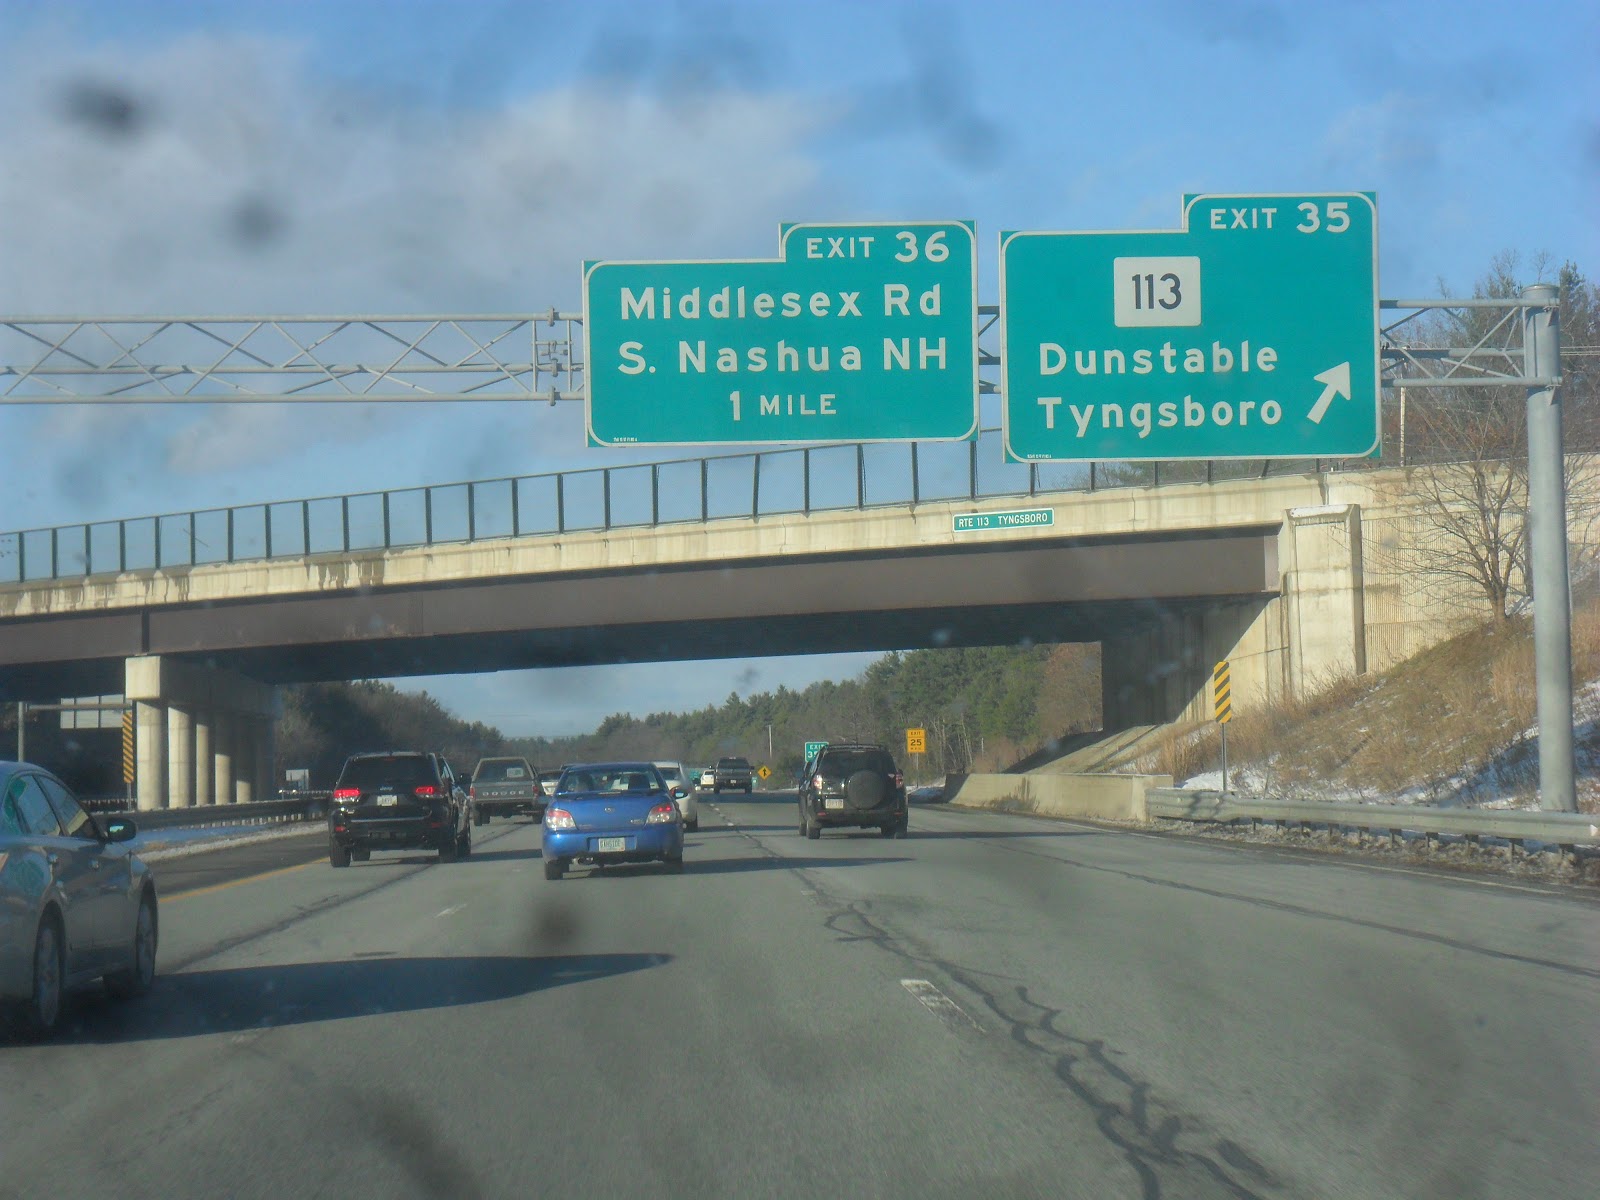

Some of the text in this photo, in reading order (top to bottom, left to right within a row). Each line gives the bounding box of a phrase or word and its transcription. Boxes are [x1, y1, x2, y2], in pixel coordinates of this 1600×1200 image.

[1210, 202, 1351, 233] EXIT 35
[806, 230, 950, 263] EXIT 36
[619, 282, 941, 320] Middlesex Rd
[1131, 273, 1182, 310] 113
[617, 336, 946, 375] S. Nashua NH
[1039, 339, 1278, 376] Dunstable
[729, 390, 837, 421] 1 MILE
[1037, 394, 1282, 439] Tyngsboro
[958, 512, 1048, 528] RTE 113 TYNGSBORO
[910, 738, 922, 746] 25
